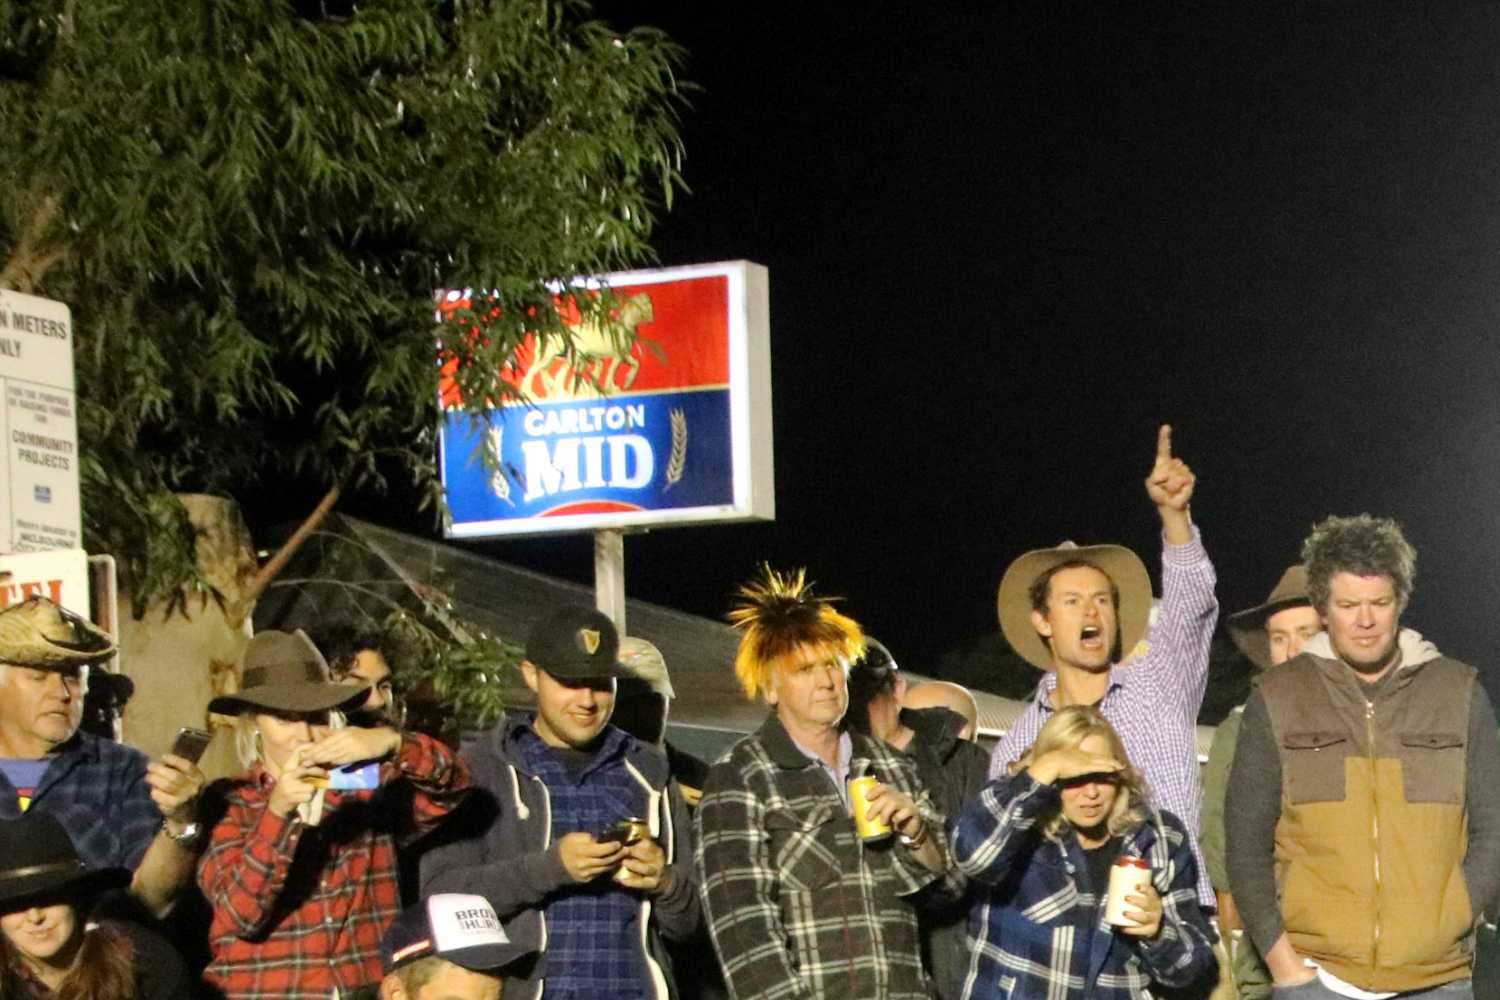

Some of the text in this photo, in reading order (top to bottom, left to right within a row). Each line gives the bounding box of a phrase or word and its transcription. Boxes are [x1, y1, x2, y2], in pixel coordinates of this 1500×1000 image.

[12, 311, 67, 340] METERS
[523, 404, 646, 437] CARLTON
[12, 429, 73, 454] COMMUNITY
[18, 447, 71, 471] PROJECTS
[521, 434, 655, 502] MID
